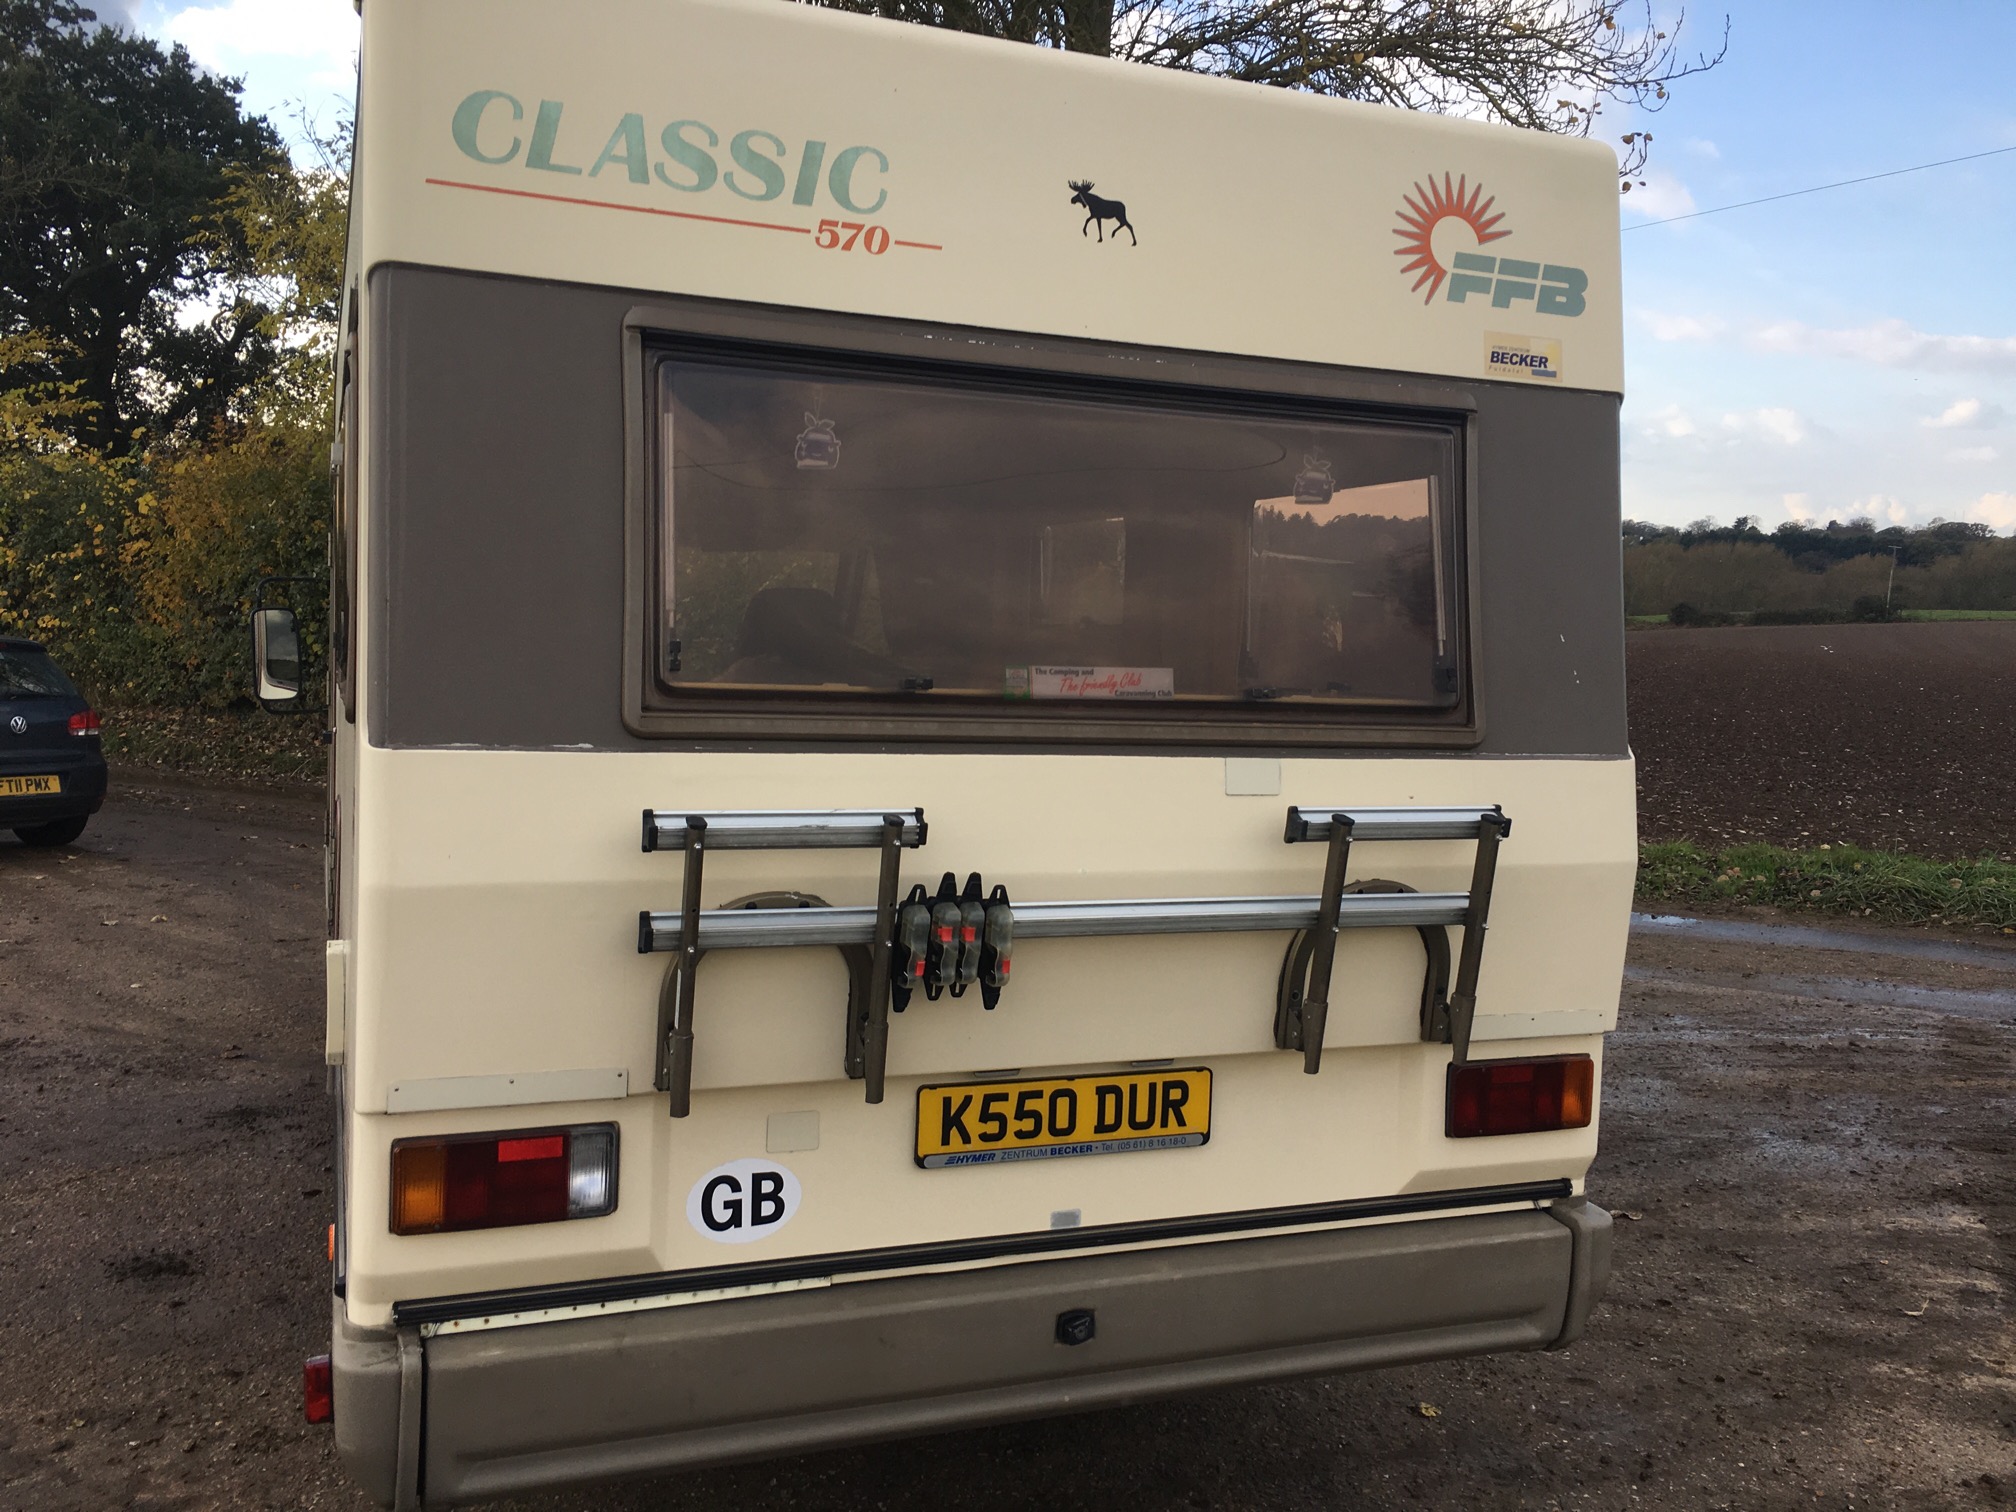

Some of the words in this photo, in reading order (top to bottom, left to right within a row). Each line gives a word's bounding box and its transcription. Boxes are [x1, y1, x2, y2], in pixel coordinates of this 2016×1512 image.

[451, 89, 890, 215] CLASSIC
[814, 218, 890, 255] 570
[1446, 251, 1589, 318] FFB
[1490, 350, 1549, 369] BECKER
[1049, 668, 1080, 677] Camping
[1060, 677, 1079, 693] The
[1078, 673, 1119, 697] friendly
[1120, 672, 1142, 688] Club
[25, 777, 51, 791] PMX
[940, 1088, 1078, 1147] K550
[1093, 1079, 1190, 1135] DUR
[954, 1153, 996, 1165] HYMER
[1001, 1148, 1048, 1160] ZENTRUM
[1050, 1144, 1093, 1156] BECKER
[1157, 1138, 1166, 1147] 16
[1169, 1136, 1187, 1146] 18-0
[700, 1170, 786, 1232] GB
